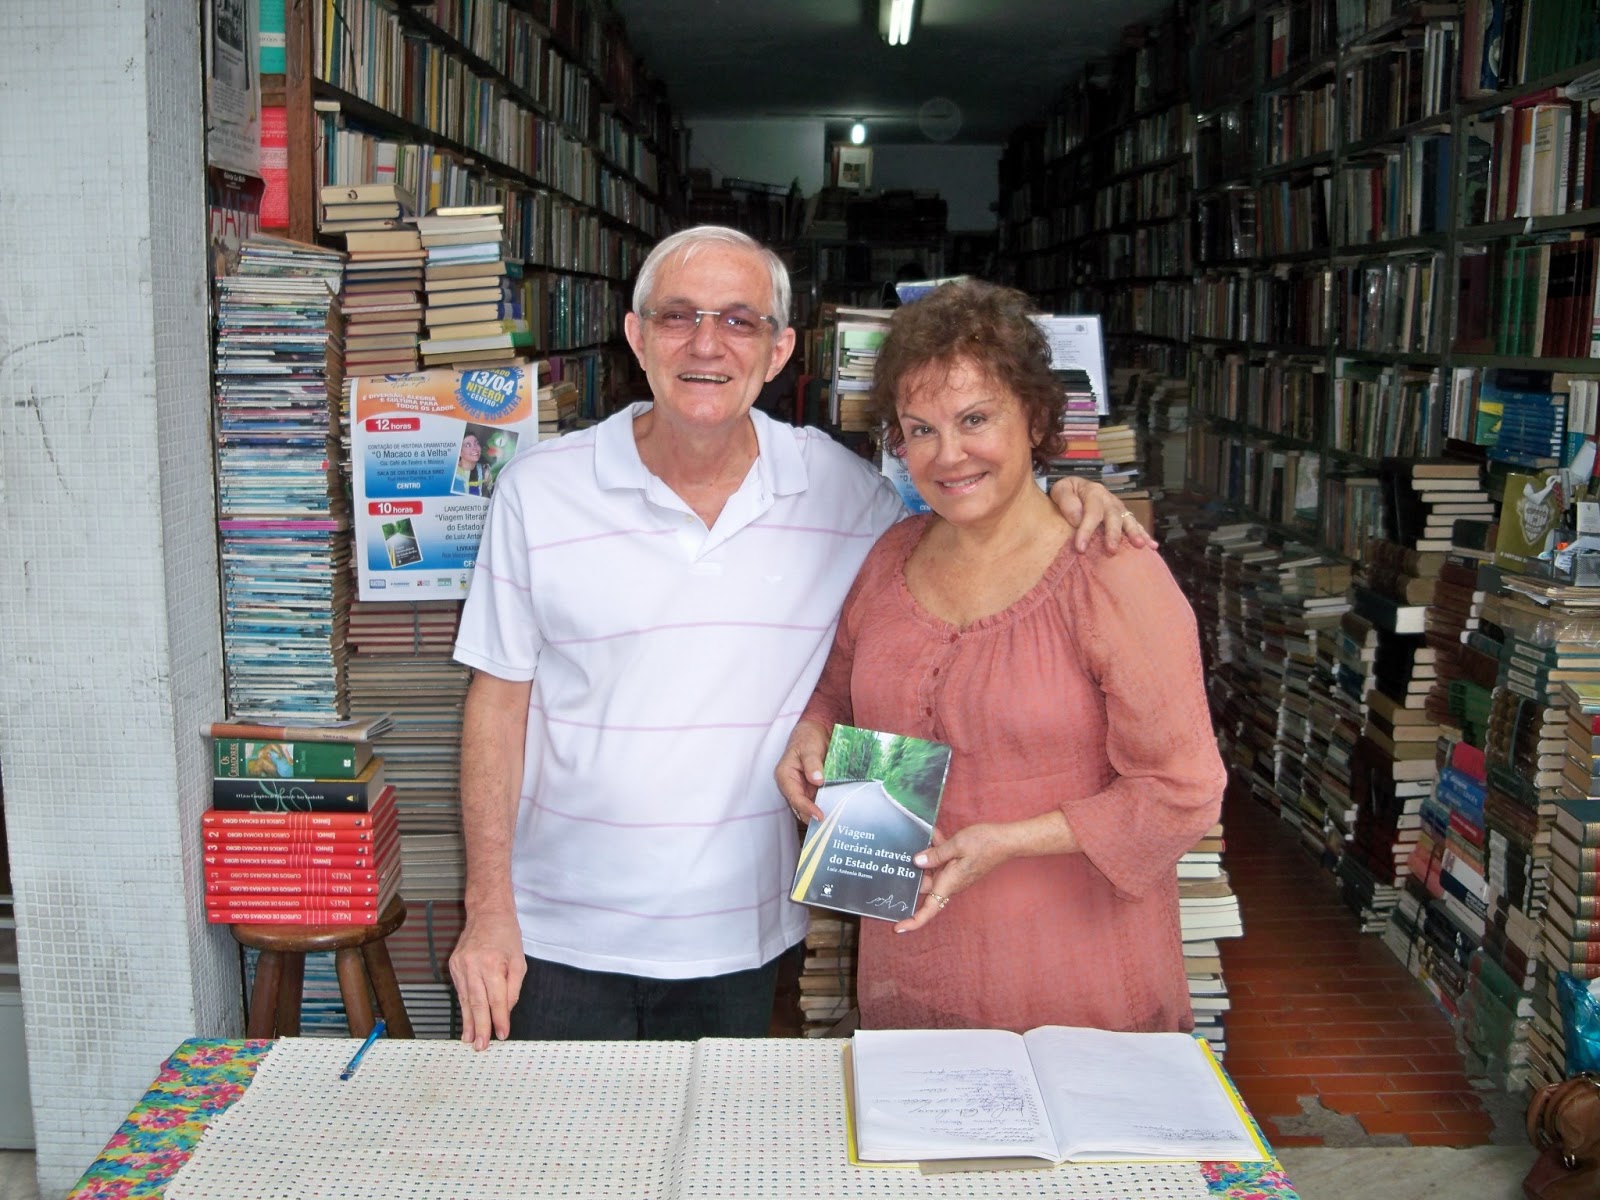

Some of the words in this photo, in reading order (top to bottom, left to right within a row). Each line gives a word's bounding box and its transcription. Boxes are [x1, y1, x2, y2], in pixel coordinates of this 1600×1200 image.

[470, 371, 514, 396] 13/04
[466, 382, 505, 403] NITERÓI
[470, 393, 496, 407] CENTRO
[376, 419, 390, 430] 12
[378, 503, 392, 513] 10
[838, 824, 875, 840] Viagem
[832, 839, 873, 855] literária
[874, 849, 912, 862] através
[829, 854, 843, 865] do
[845, 857, 879, 872] Estado
[881, 864, 895, 875] do
[896, 866, 916, 879] Rio
[838, 868, 857, 876] Antonio
